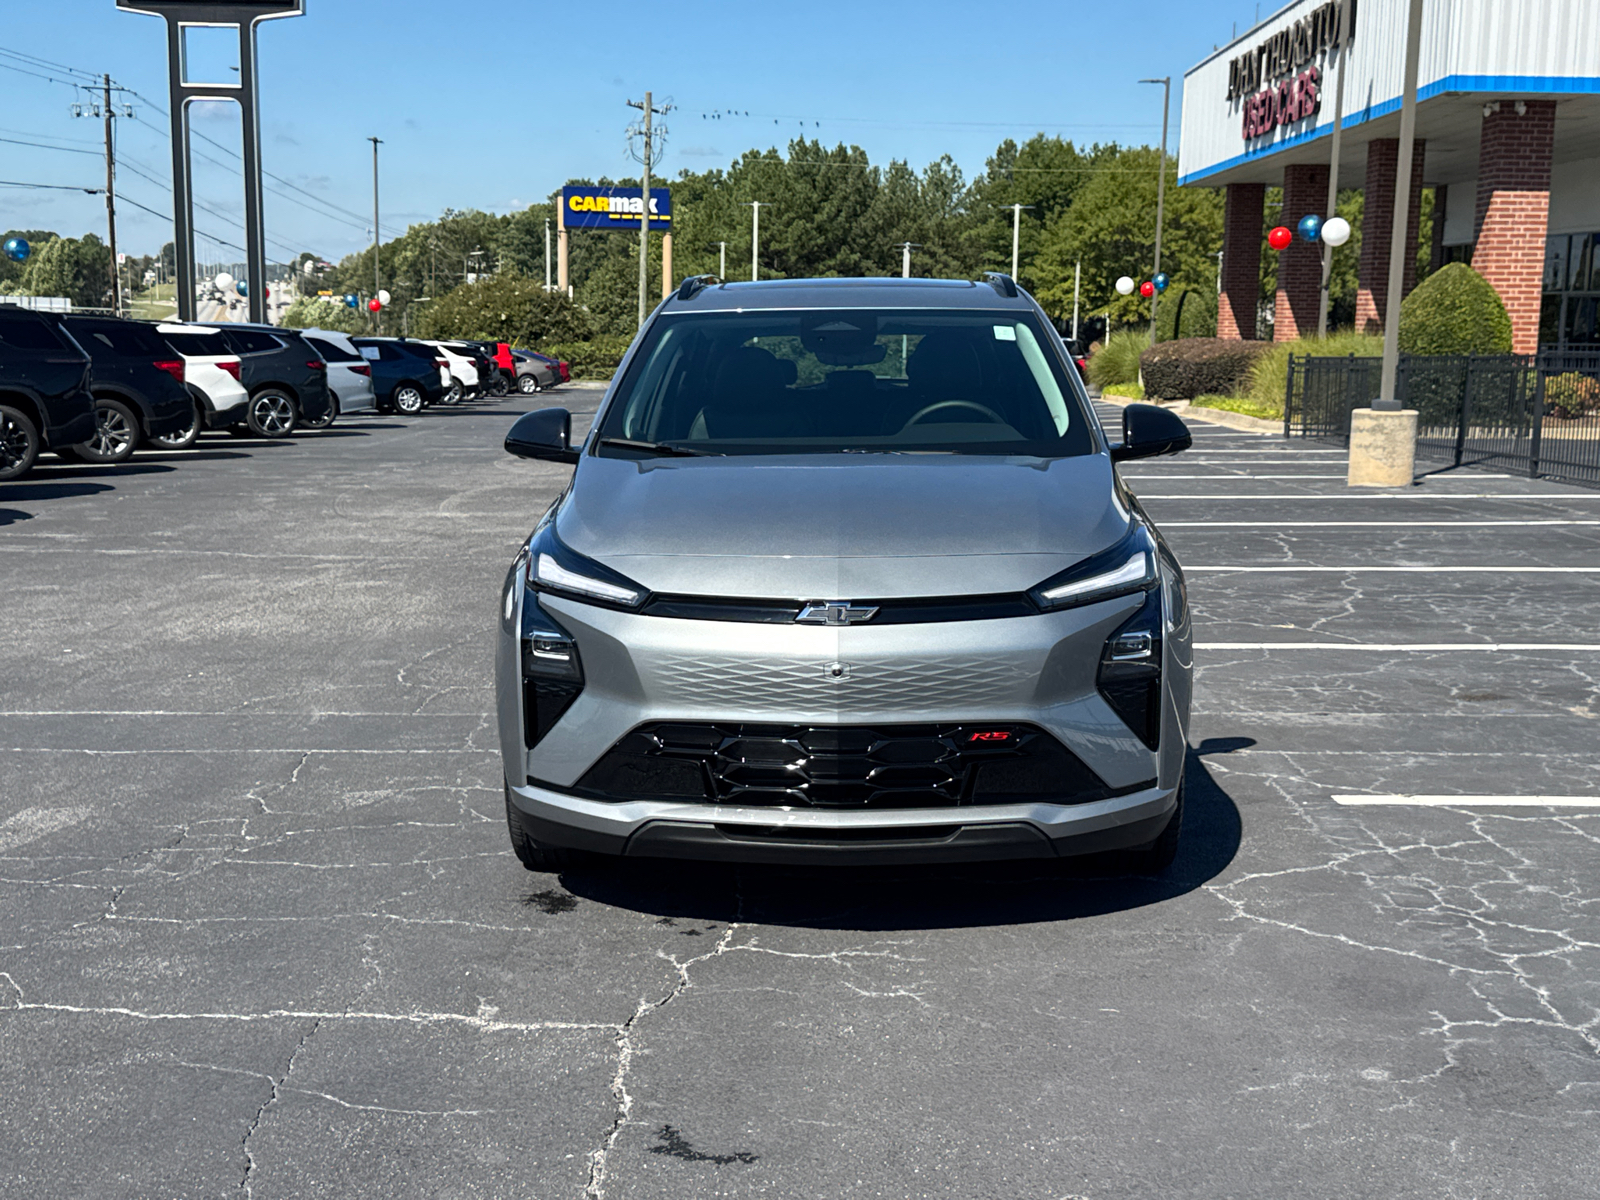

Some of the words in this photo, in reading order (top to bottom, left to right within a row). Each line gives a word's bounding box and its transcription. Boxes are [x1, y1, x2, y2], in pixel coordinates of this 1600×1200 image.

[1263, 0, 1357, 82] THORNTO
[1242, 88, 1278, 140] USED
[1276, 65, 1321, 125] CARS
[968, 731, 1011, 742] RS
